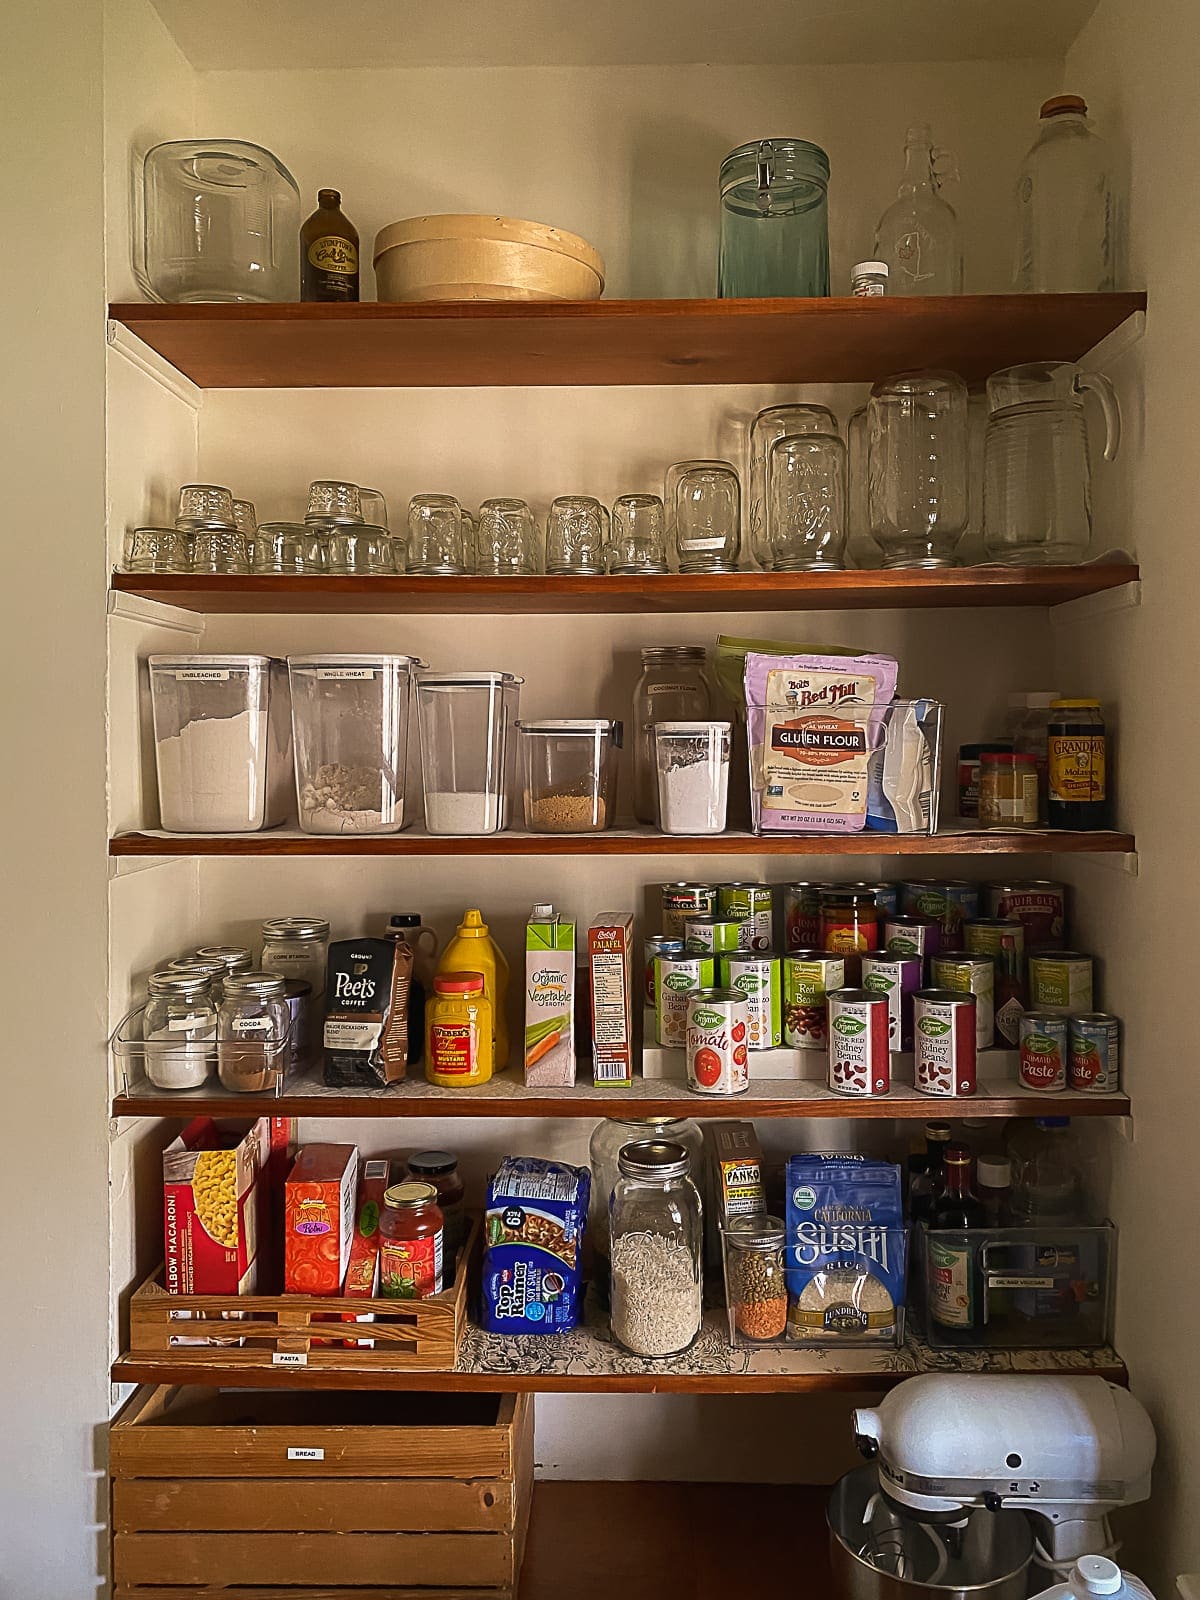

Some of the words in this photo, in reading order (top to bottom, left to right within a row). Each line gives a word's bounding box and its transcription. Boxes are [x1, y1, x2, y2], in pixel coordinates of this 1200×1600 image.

[788, 680, 810, 690] Bob's
[800, 686, 828, 706] Red
[828, 682, 857, 704] Mill
[780, 733, 820, 745] GLUTEN
[823, 735, 859, 747] FLOUR
[592, 940, 622, 949] FALAFEL
[335, 972, 376, 999] Peet's
[532, 972, 568, 986] Organic
[798, 983, 815, 994] Red
[1038, 982, 1062, 994] Butter
[528, 988, 572, 1007] Vegetable
[834, 1041, 864, 1053] Kidney
[920, 1042, 948, 1055] Kidney
[837, 1050, 862, 1061] Beans
[921, 1051, 947, 1063] Beans
[1026, 1055, 1052, 1063] TOMATO
[1022, 1061, 1055, 1078] Paste
[727, 1169, 759, 1182] PANKO
[293, 1208, 332, 1230] PASTA
[506, 1217, 521, 1226] 6
[814, 1209, 873, 1222] CALIFORNIA
[167, 1194, 177, 1253] MACARONI
[826, 1261, 864, 1270] RICE
[169, 1257, 178, 1295] ELBOW
[527, 1269, 537, 1286] SAUC
[511, 1262, 527, 1318] Ramen
[527, 1287, 536, 1302] SOY
[496, 1285, 514, 1318] Top
[824, 1307, 868, 1325] LUNDBERG
